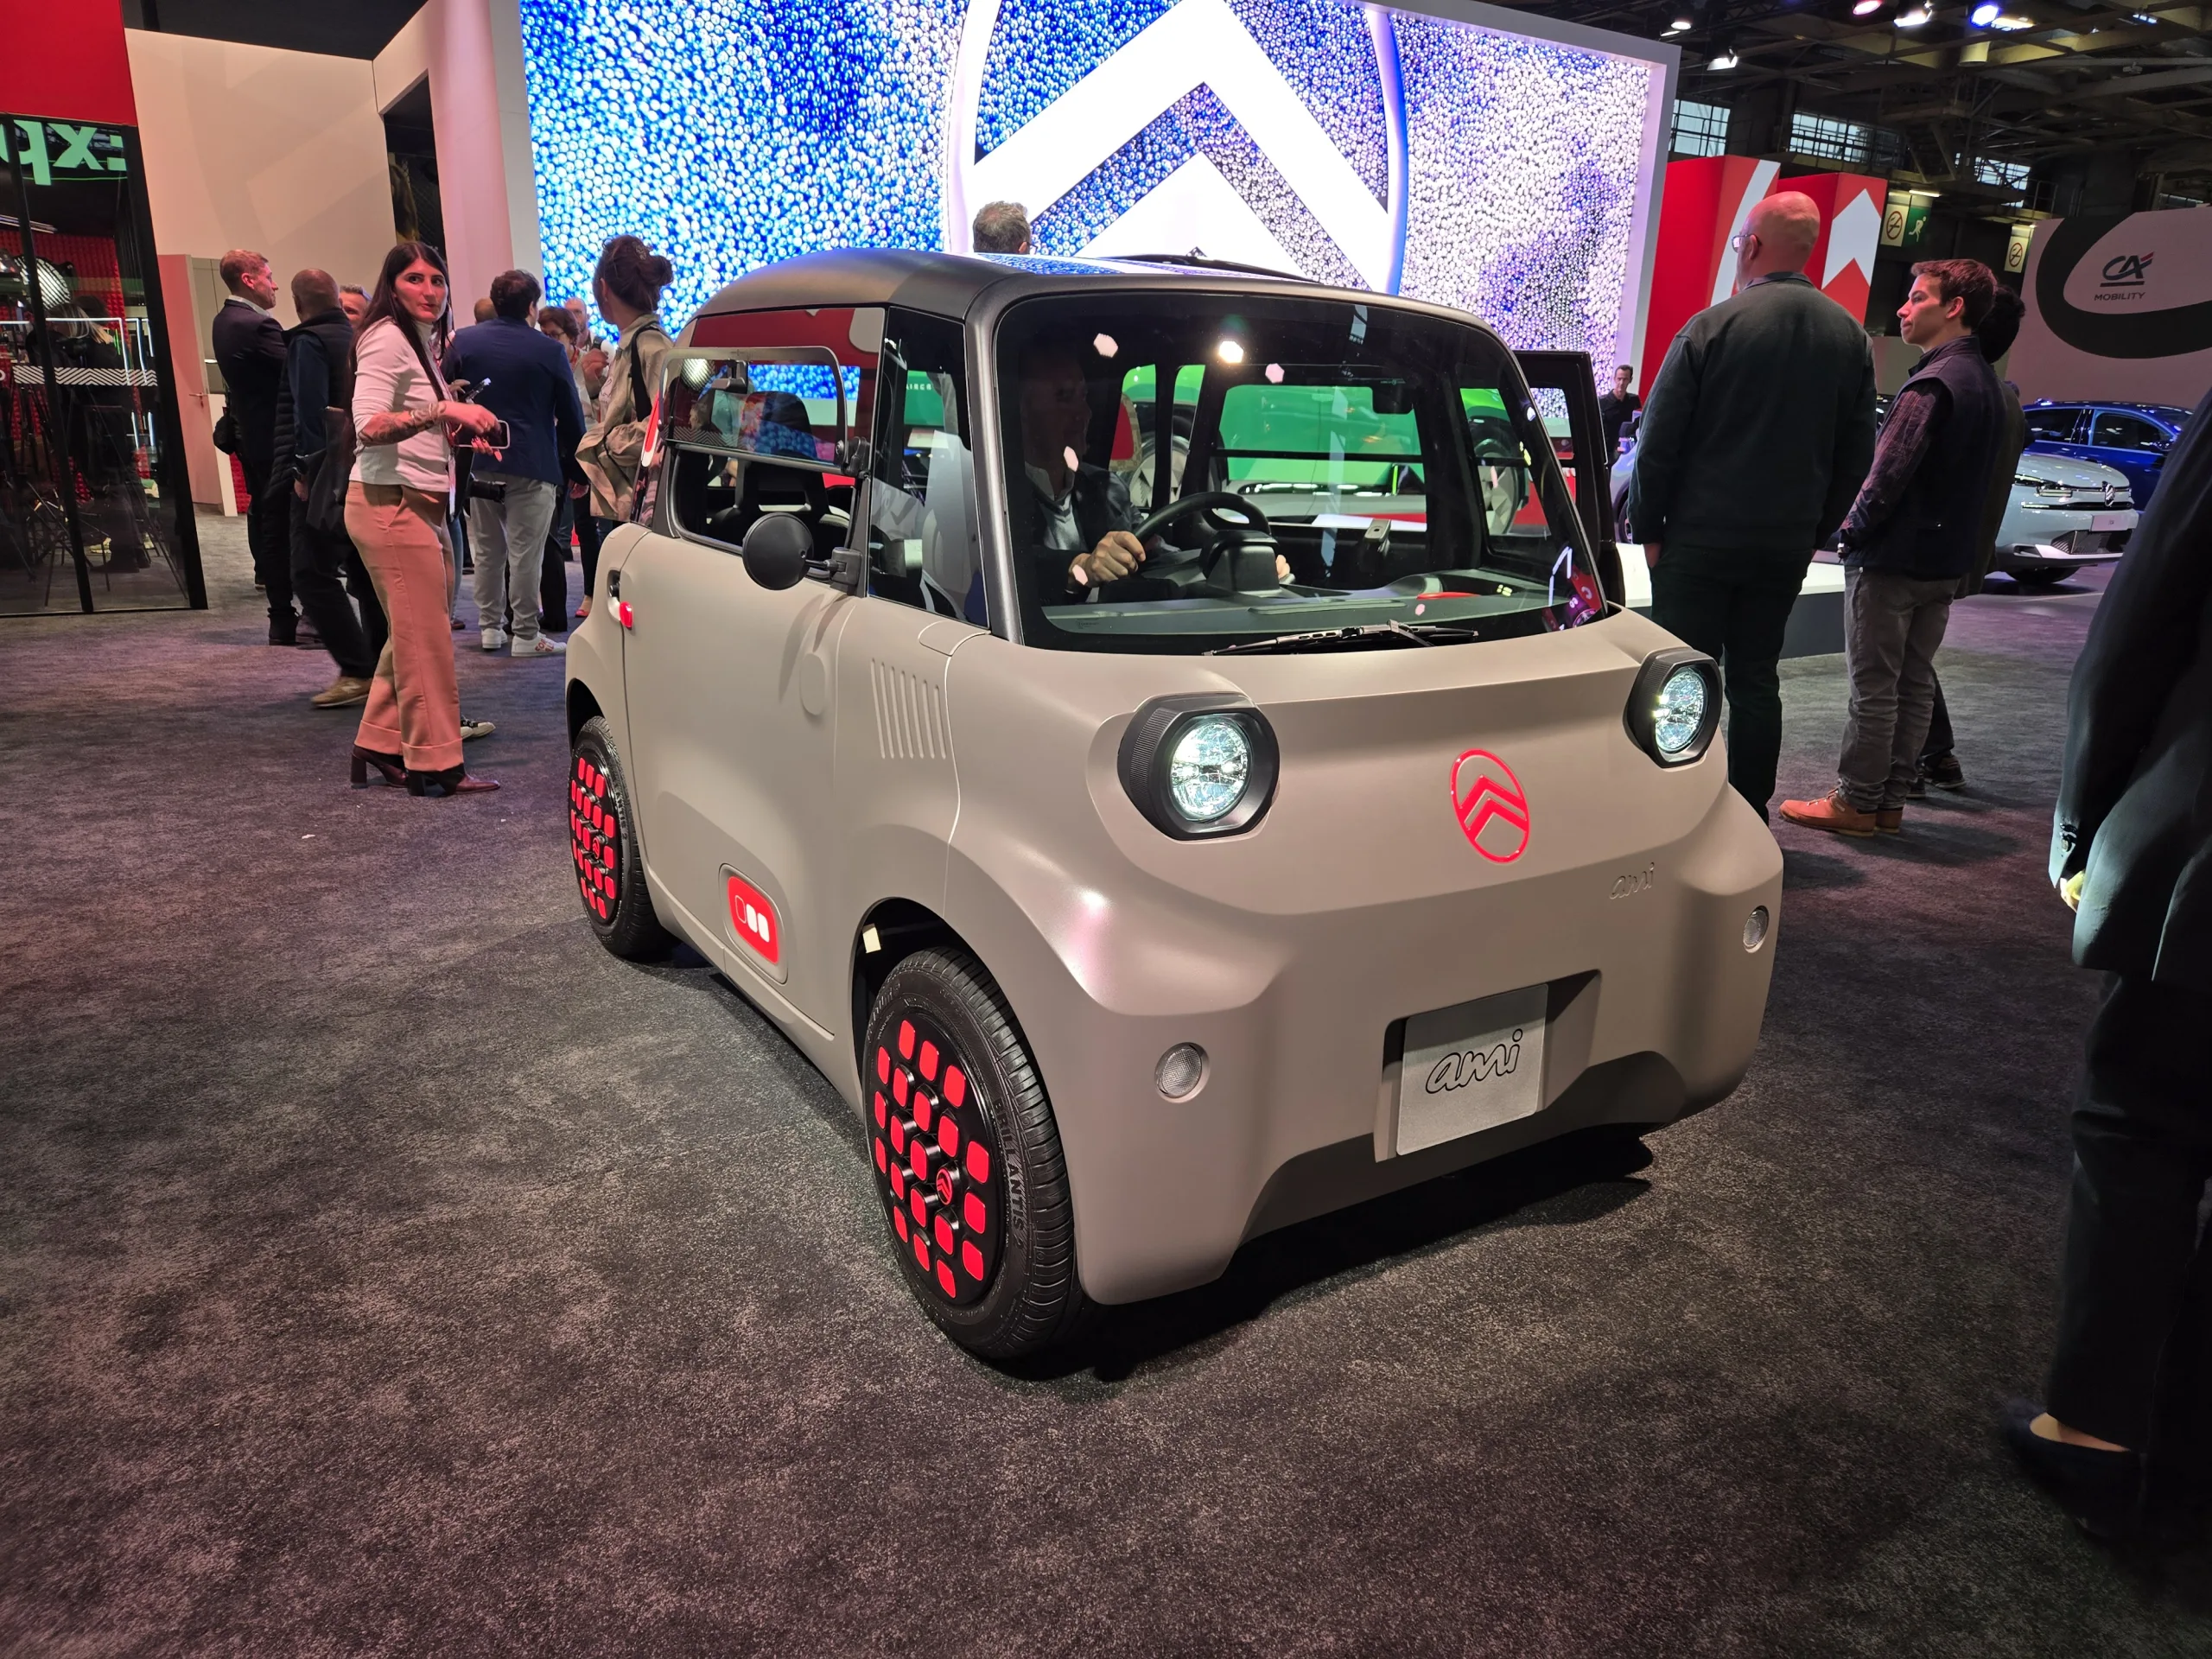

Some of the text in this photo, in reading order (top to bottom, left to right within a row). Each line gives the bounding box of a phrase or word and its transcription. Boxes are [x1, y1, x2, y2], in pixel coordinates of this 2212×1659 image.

[2102, 252, 2154, 281] CA
[2094, 292, 2146, 302] MOBILITY
[1609, 861, 1656, 900] ami
[1425, 1027, 1523, 1095] ami
[994, 1096, 1026, 1232] BRILLANTIS
